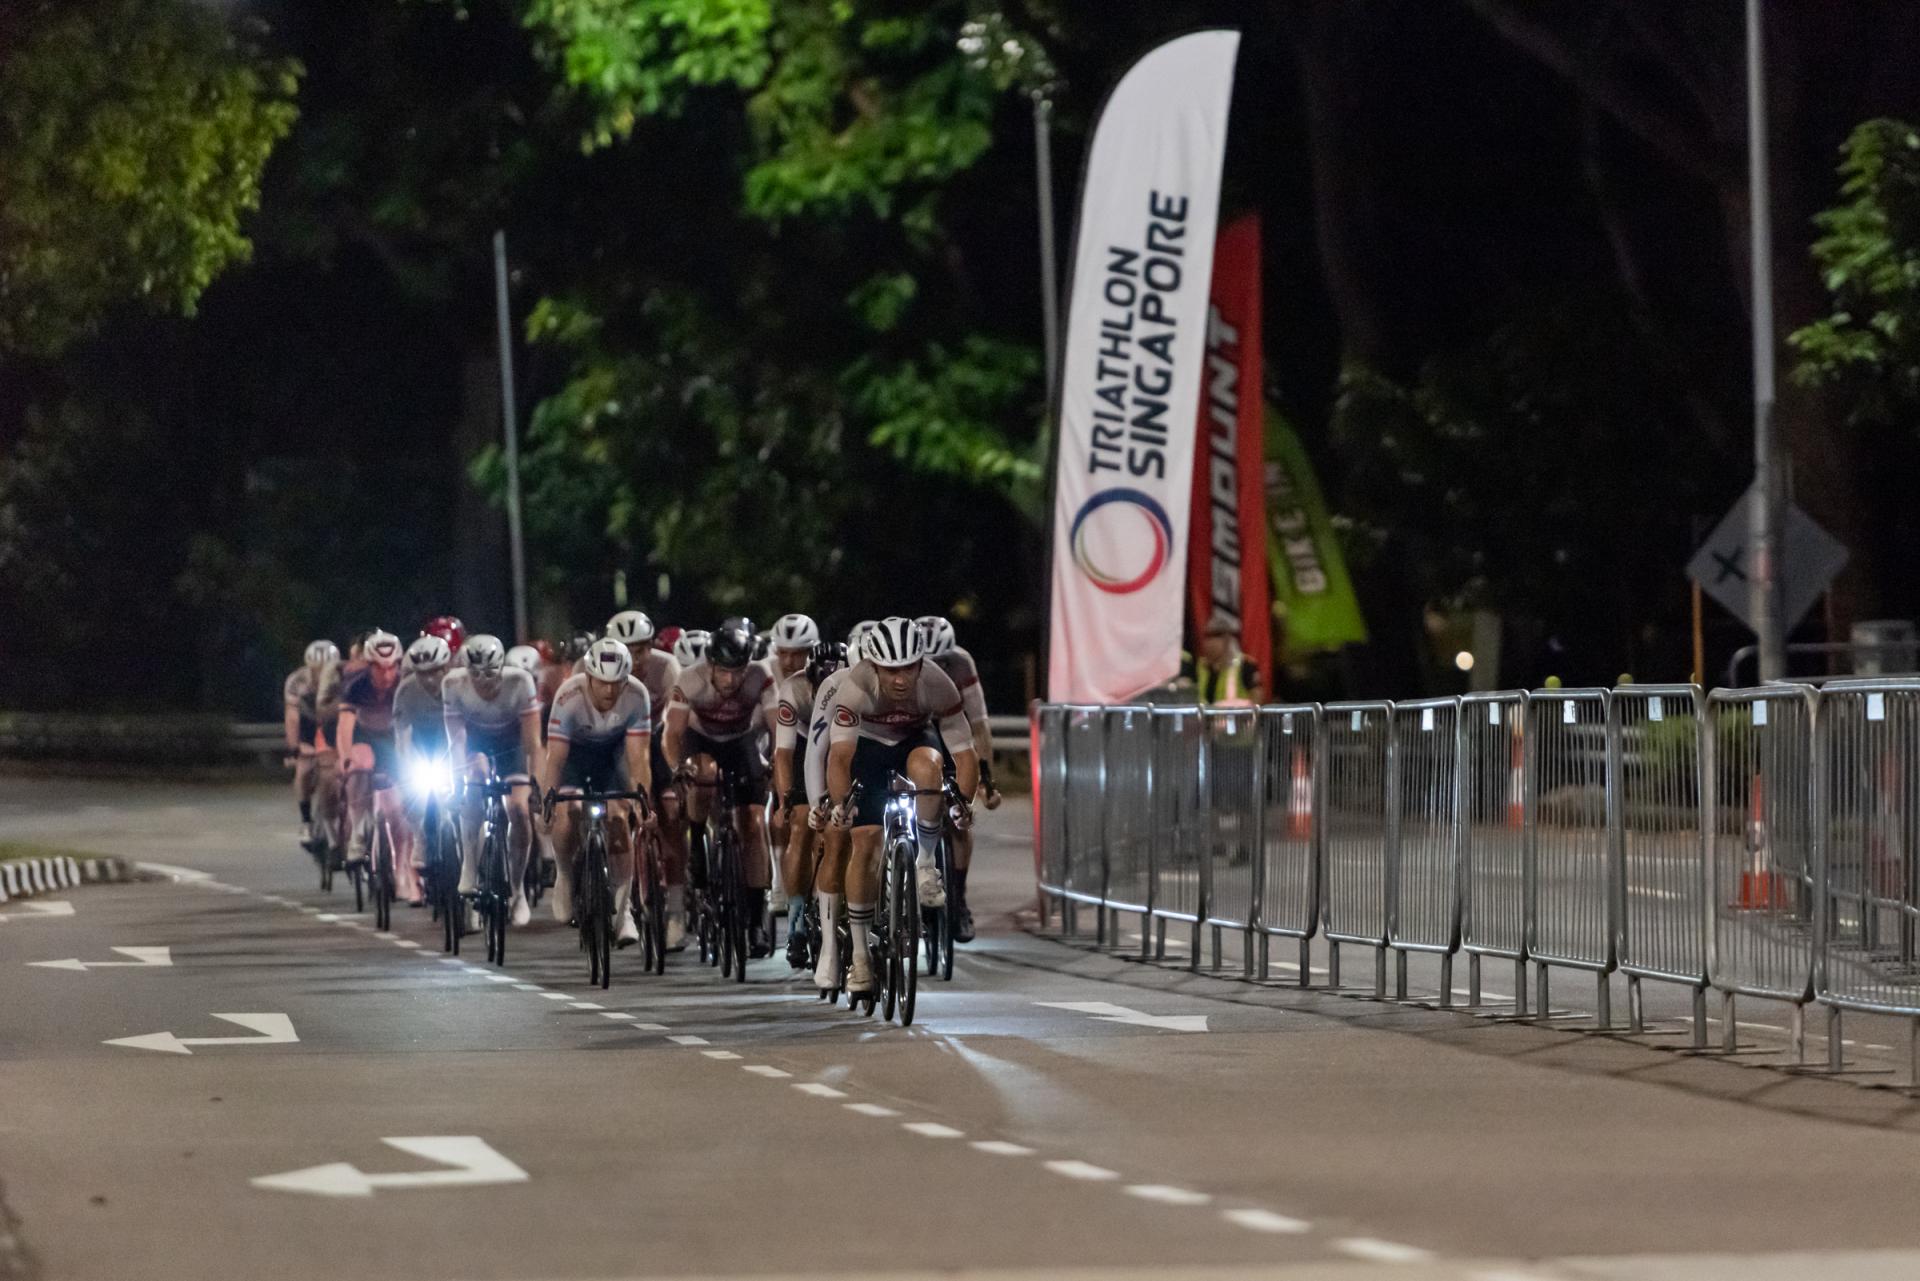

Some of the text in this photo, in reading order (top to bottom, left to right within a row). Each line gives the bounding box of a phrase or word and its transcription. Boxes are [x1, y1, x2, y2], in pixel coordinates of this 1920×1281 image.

[1087, 246, 1140, 475] TRIATHLON
[1126, 190, 1190, 480] SINGAPORE
[1207, 303, 1241, 648] ISMOUNT
[820, 686, 837, 710] LOGOS
